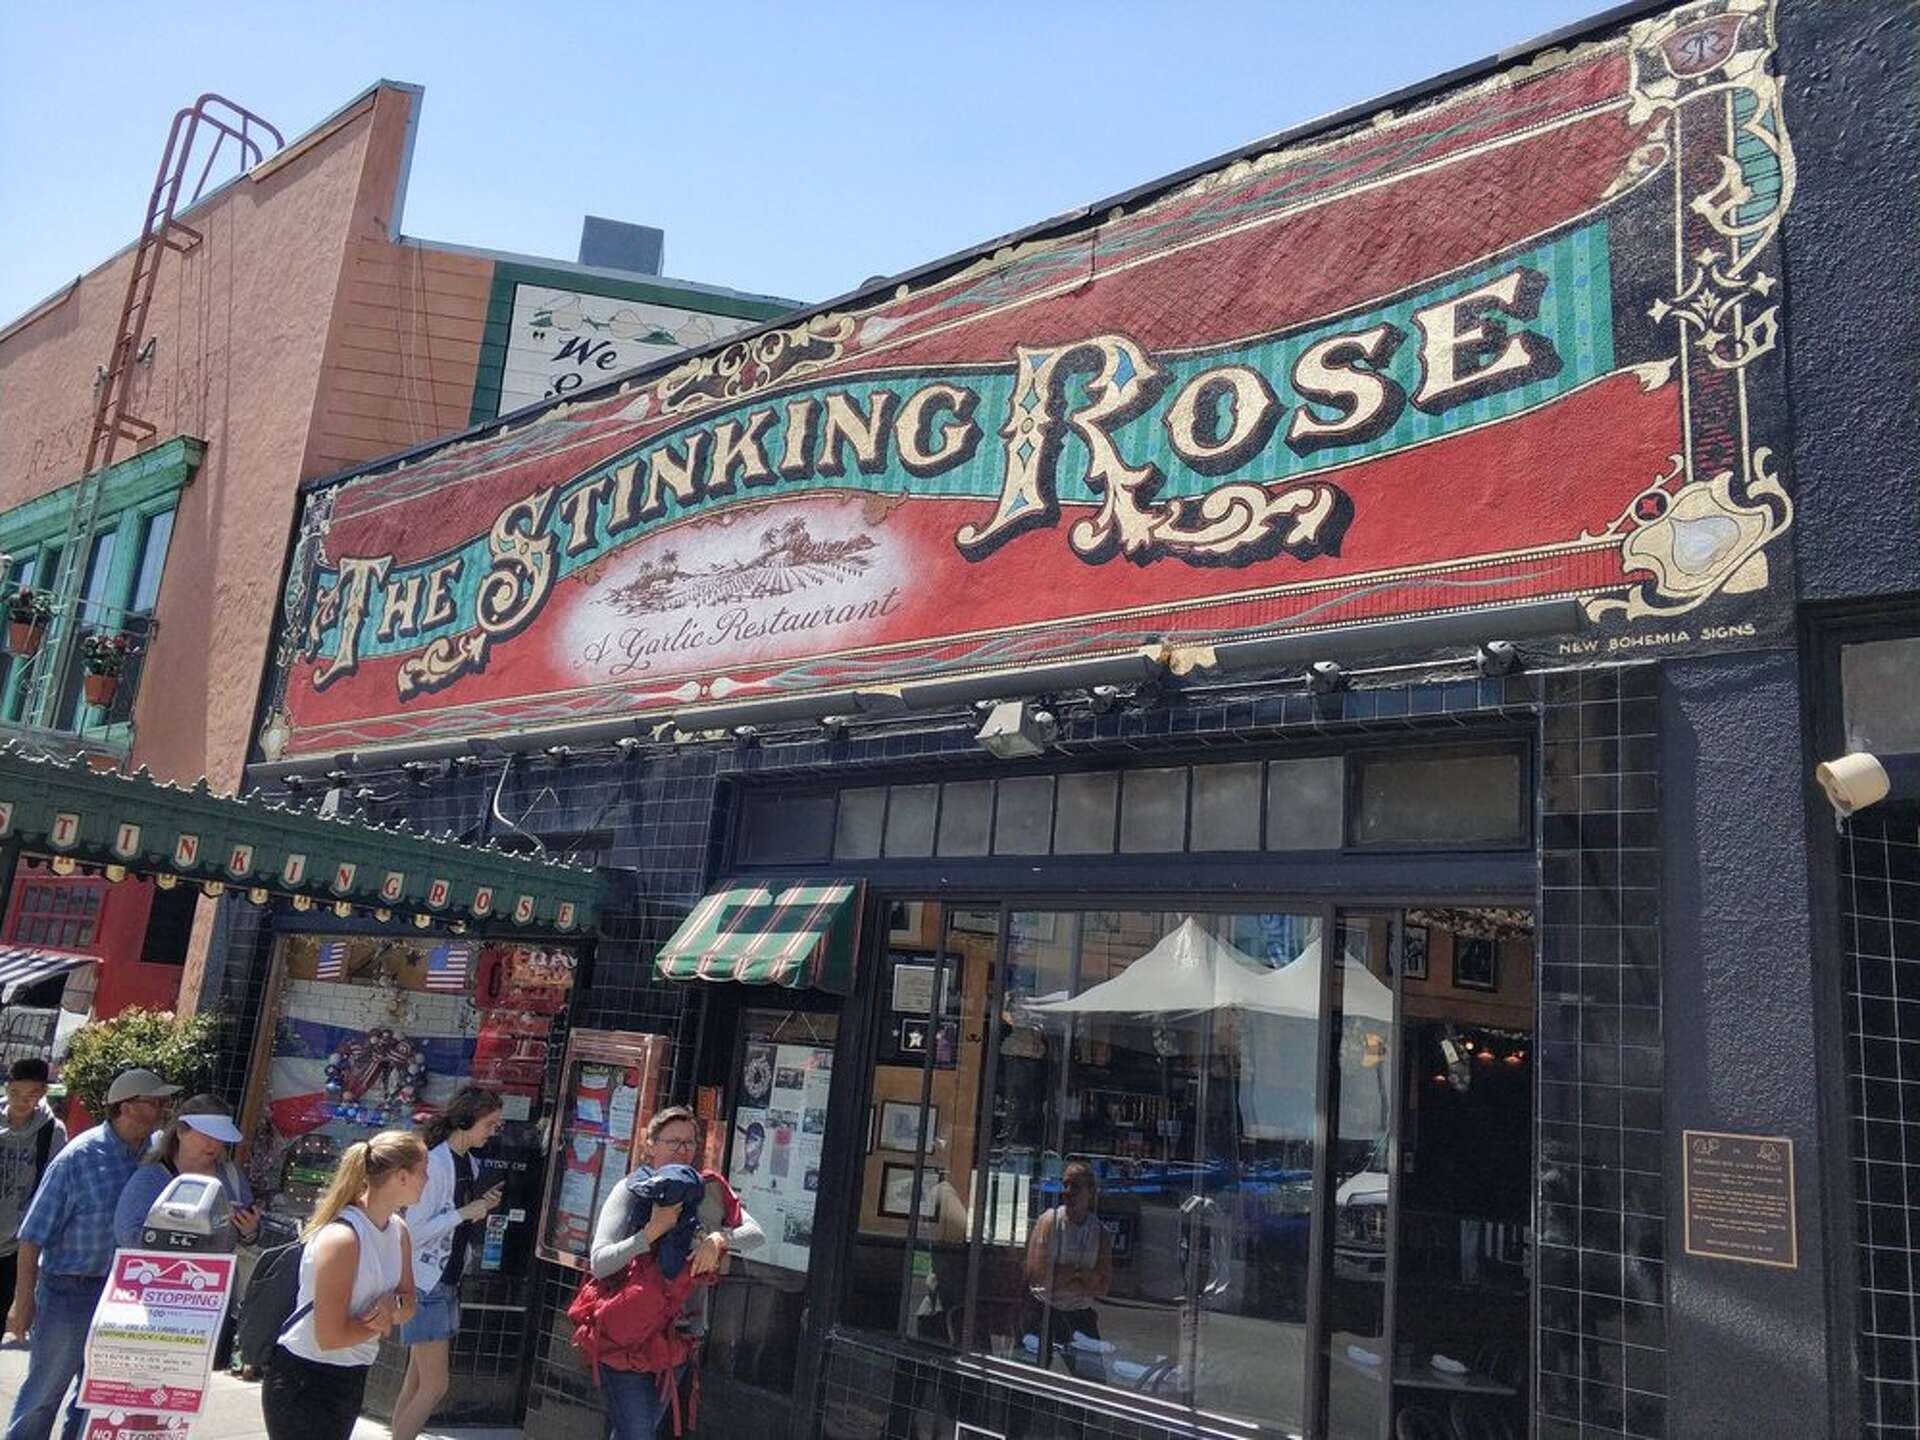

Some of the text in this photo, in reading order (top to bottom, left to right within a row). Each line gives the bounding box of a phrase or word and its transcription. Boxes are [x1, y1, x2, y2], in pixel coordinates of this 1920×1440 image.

[306, 266, 1562, 700] THE STINKING ROSE
[573, 587, 903, 675] A Garlic Restaurant
[1559, 623, 1756, 655] NEW BOHEMIA SIGNS
[110, 1288, 219, 1307] NO STOPPING
